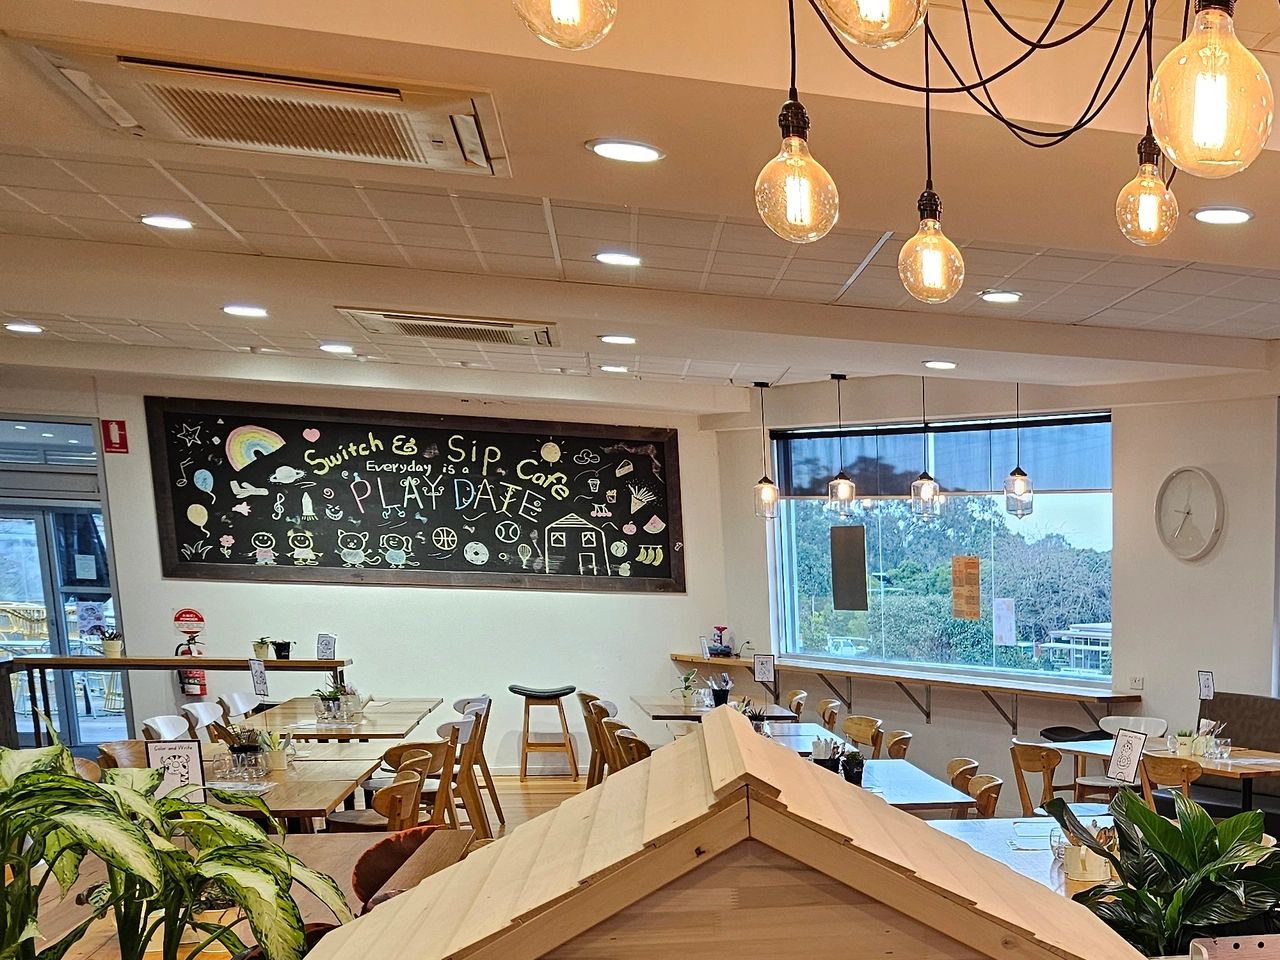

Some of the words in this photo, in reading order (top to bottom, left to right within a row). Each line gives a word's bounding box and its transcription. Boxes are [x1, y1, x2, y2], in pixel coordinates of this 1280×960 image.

[303, 431, 384, 476] Switch
[447, 434, 502, 477] Sip
[365, 459, 432, 477] Everyday
[442, 463, 455, 475] is
[462, 465, 470, 475] a
